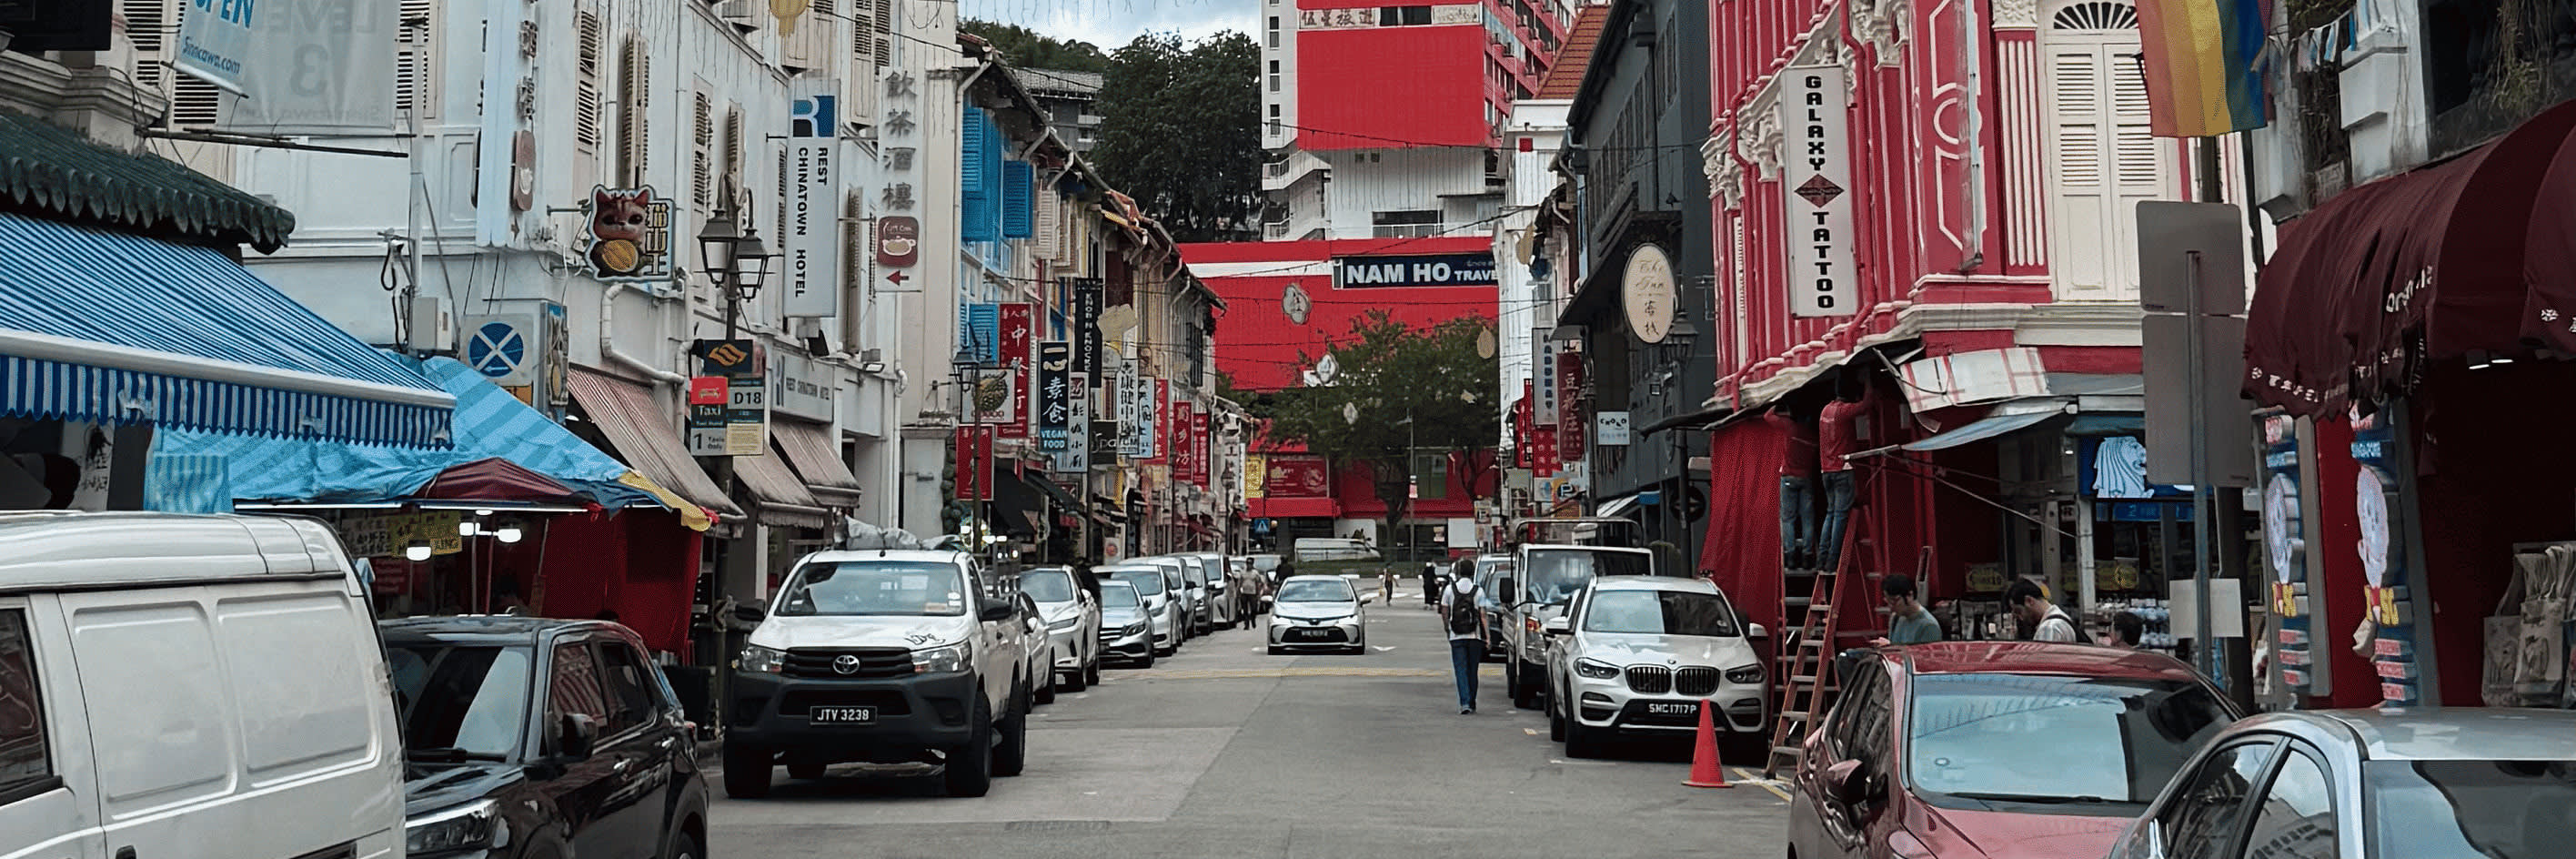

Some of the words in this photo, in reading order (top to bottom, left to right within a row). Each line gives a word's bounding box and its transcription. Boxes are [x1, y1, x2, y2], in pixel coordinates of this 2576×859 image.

[1805, 76, 1826, 171] GALAXY
[817, 147, 829, 187] REST
[796, 147, 809, 237] CHINATOWN
[1812, 211, 1835, 308] TATTOO
[795, 249, 806, 298] HOTEL
[1346, 263, 1404, 284] NAM
[1413, 262, 1451, 283] HO
[734, 391, 762, 405] D18
[699, 405, 721, 416] Taxi
[693, 433, 703, 450] 1
[1041, 430, 1067, 438] VEGAN
[1043, 440, 1065, 449] FOOD
[817, 709, 839, 722] JTV
[840, 709, 870, 721] 3238
